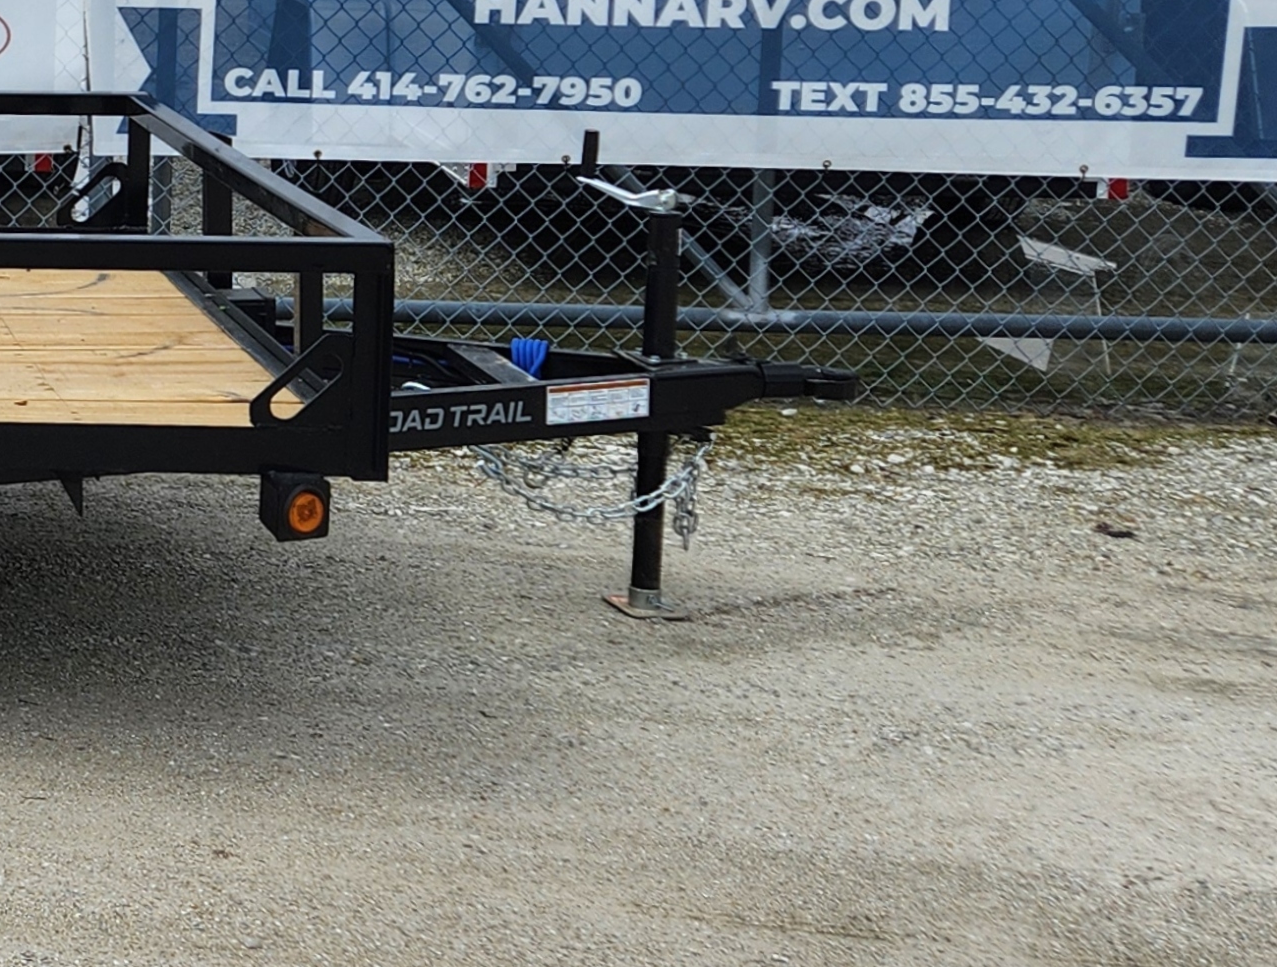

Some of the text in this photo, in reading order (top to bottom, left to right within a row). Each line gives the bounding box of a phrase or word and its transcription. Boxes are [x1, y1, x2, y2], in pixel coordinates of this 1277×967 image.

[224, 67, 643, 107] CALL 414-762-7950
[771, 81, 1204, 117] TEXT 855-432-6357
[389, 408, 444, 433] OAD
[449, 400, 532, 428] TRAIL
